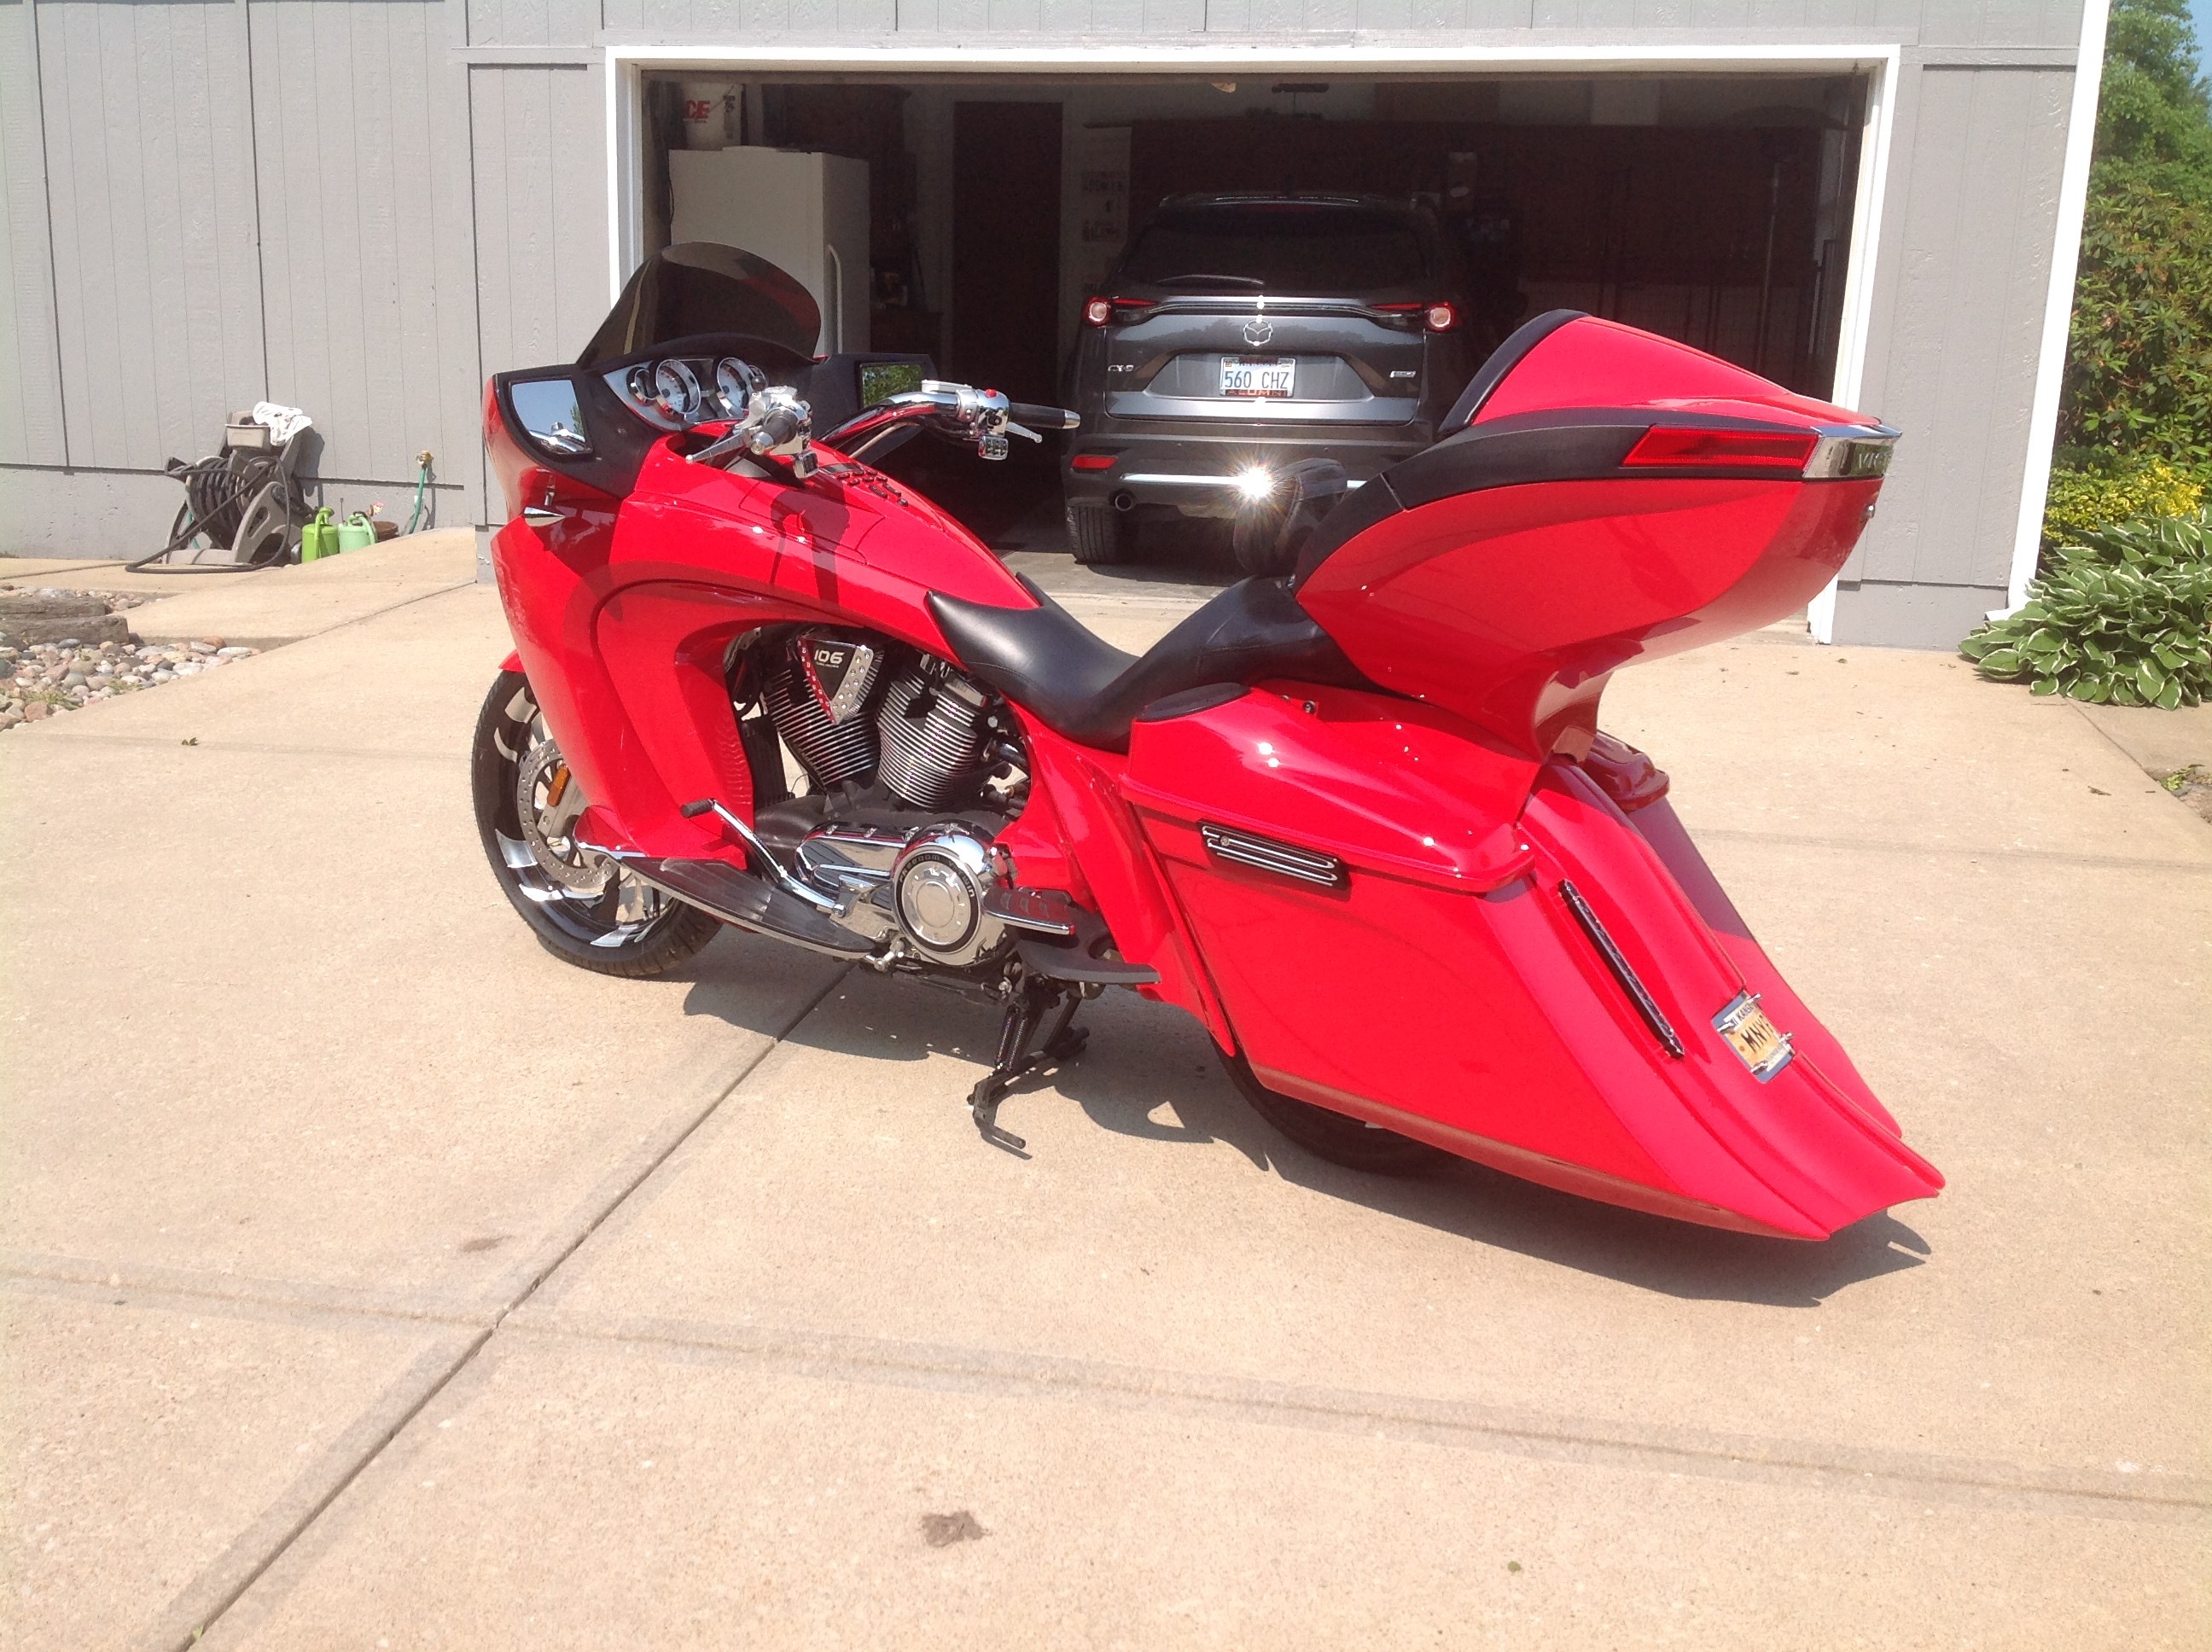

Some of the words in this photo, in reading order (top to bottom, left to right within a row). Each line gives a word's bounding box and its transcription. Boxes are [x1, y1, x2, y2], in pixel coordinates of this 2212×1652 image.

[685, 99, 710, 119] CE
[1225, 370, 1252, 388] 560
[1261, 371, 1289, 389] CHZ
[813, 649, 846, 665] 106
